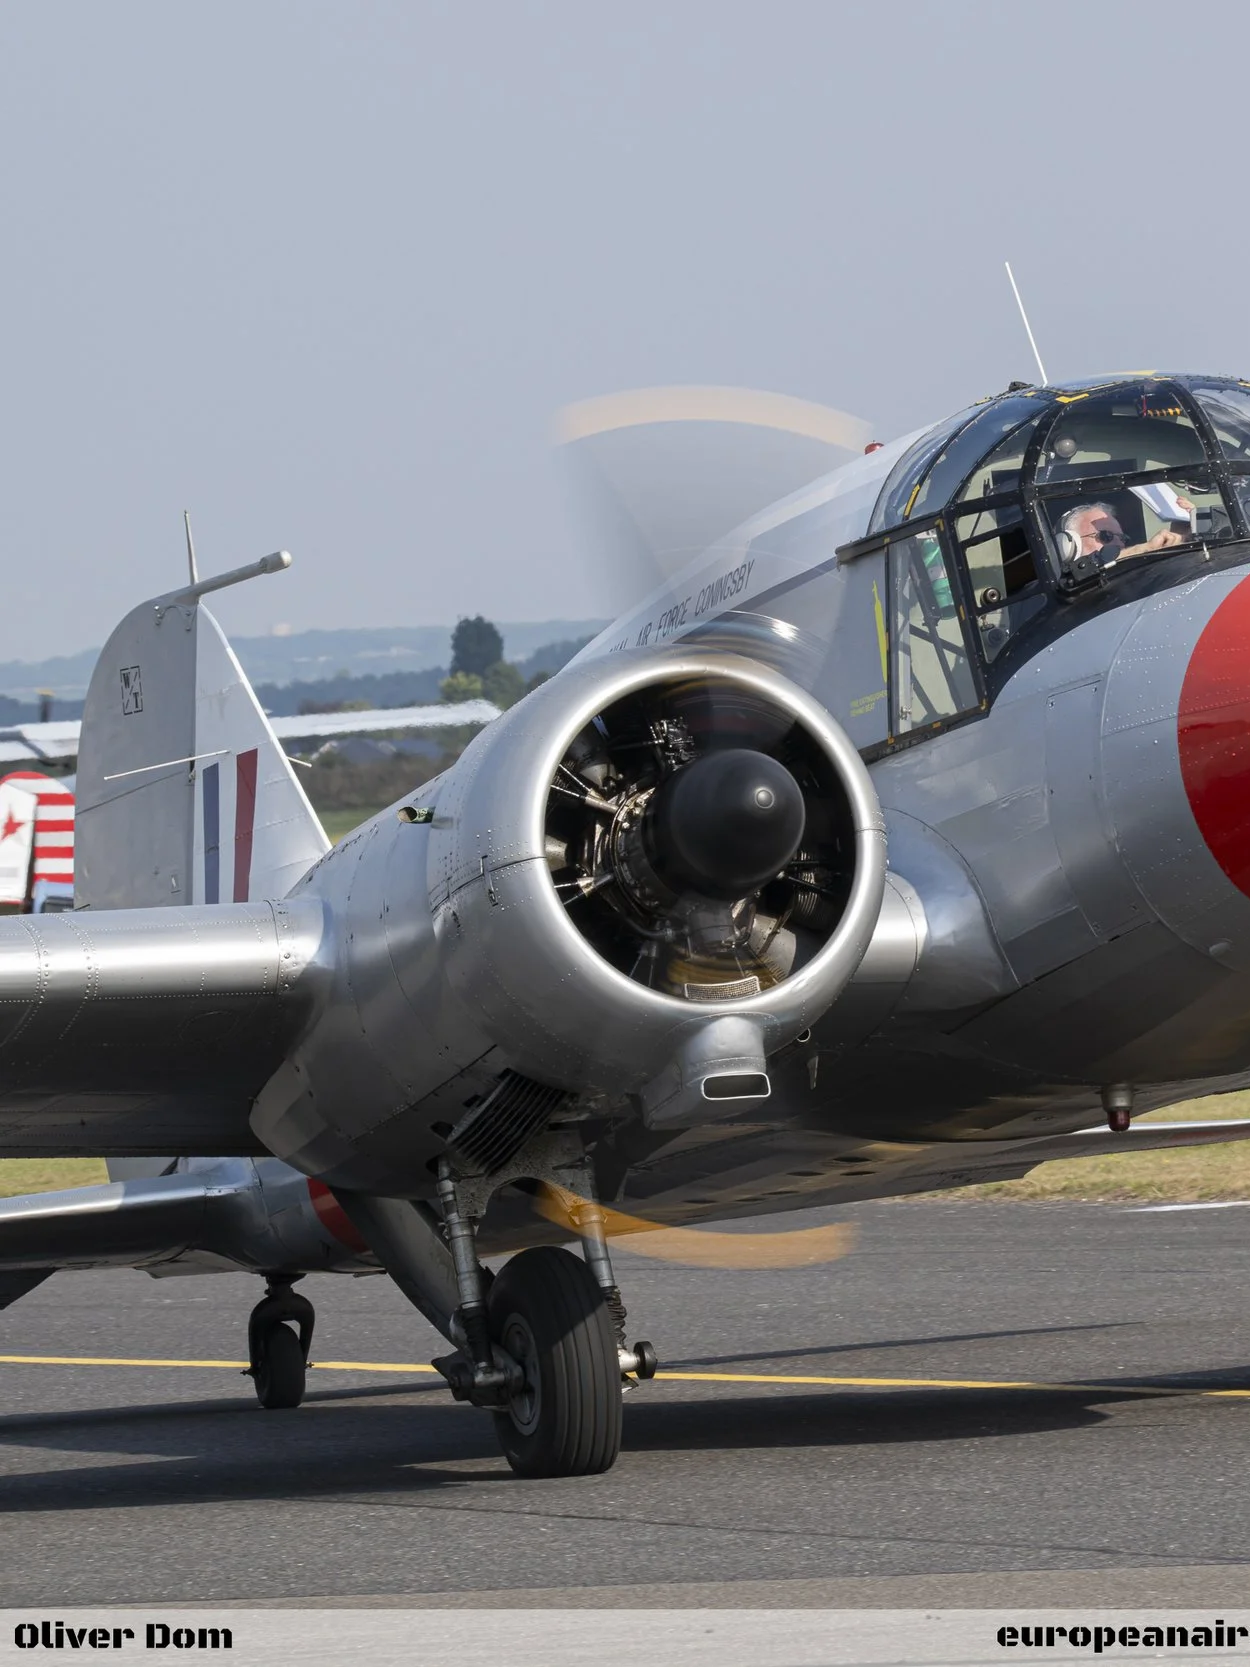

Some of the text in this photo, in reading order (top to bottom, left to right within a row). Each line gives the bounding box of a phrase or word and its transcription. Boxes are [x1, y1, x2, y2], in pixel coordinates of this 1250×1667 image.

[636, 559, 755, 647] AIR FORCE CONINGSBY
